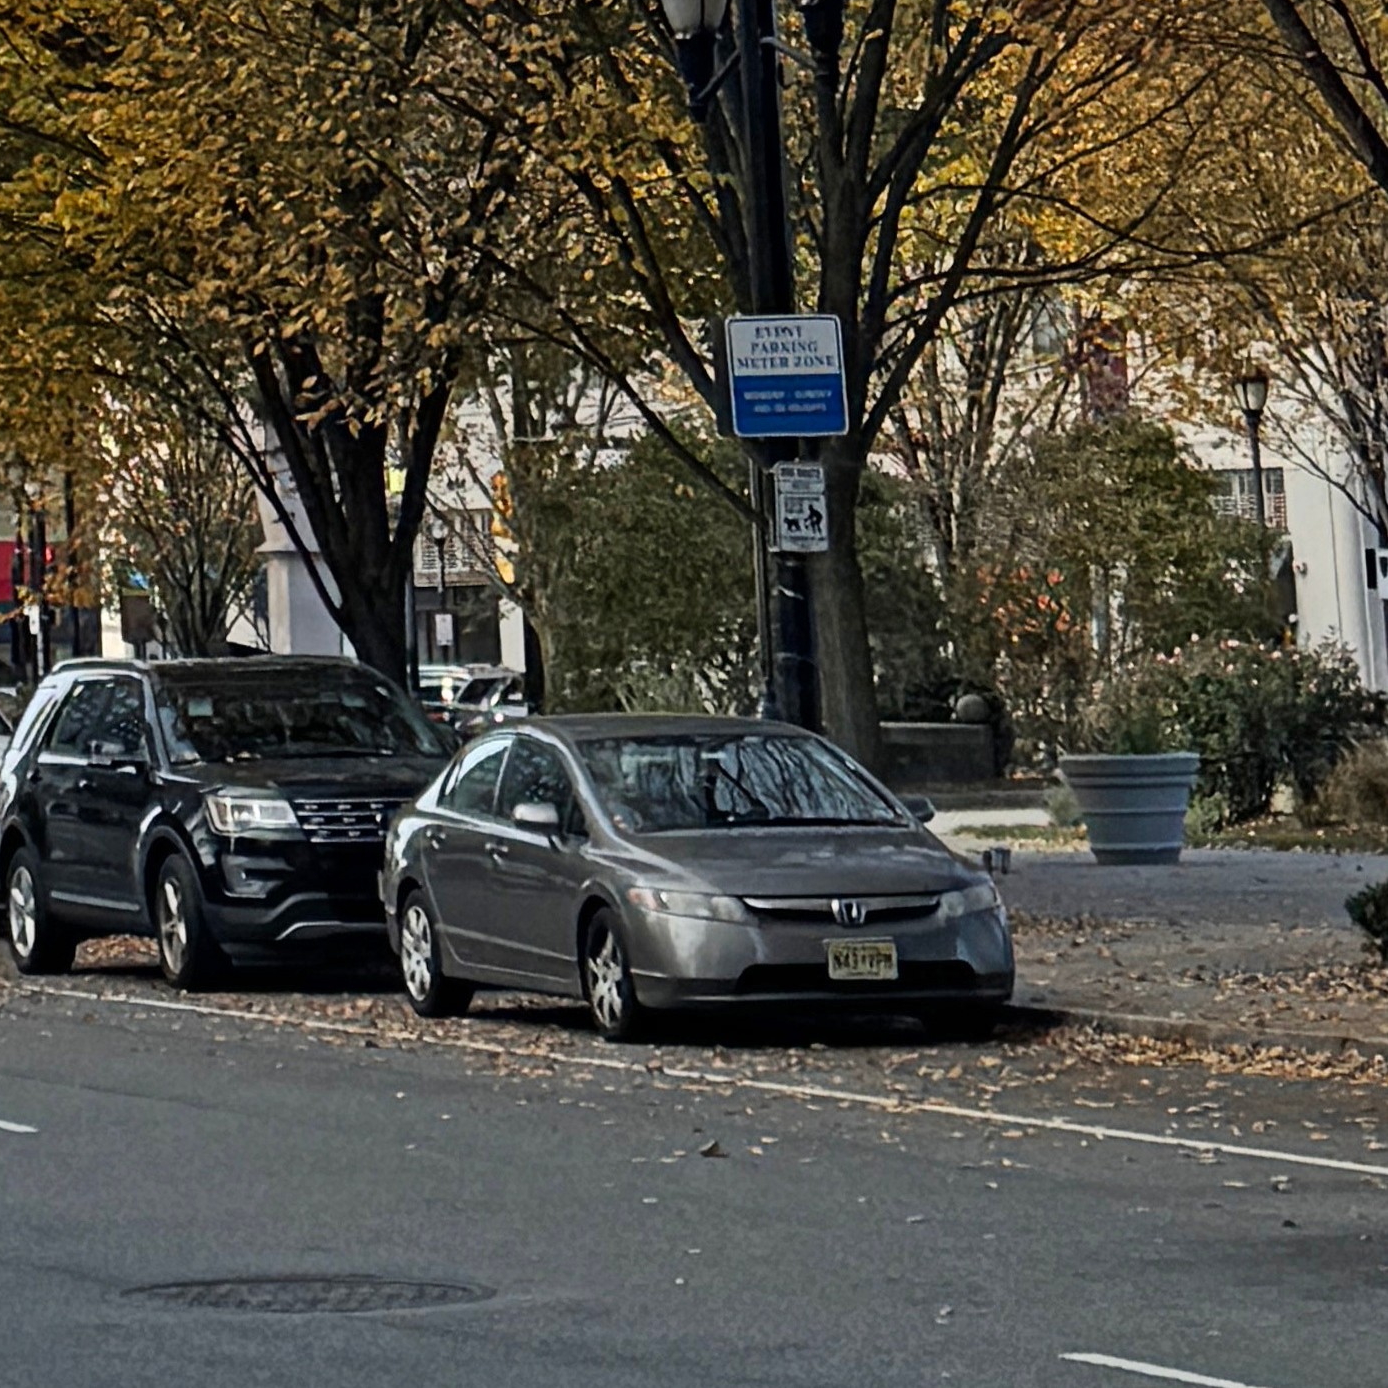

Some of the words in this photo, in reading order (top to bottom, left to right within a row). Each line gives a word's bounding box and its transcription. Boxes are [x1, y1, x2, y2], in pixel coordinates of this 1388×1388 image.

[751, 341, 817, 355] PARKING
[737, 357, 789, 370] METER
[793, 355, 834, 368] ZONE
